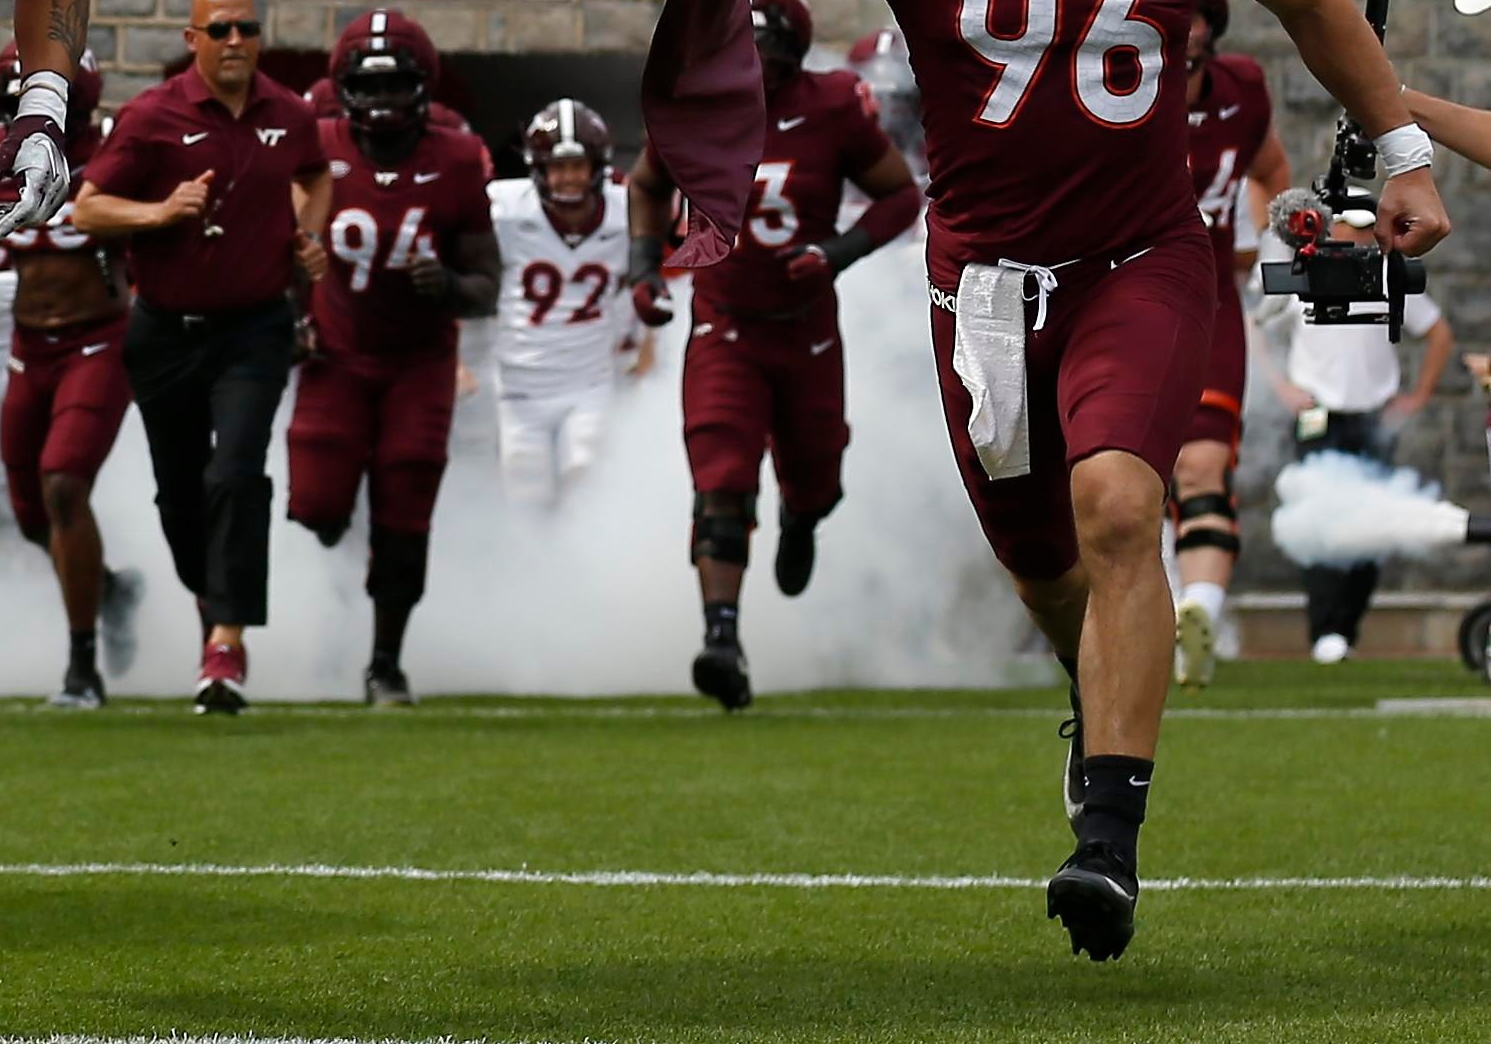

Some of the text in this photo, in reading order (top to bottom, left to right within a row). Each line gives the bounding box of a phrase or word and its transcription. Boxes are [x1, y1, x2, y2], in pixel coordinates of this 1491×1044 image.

[255, 127, 287, 146] VT
[737, 160, 800, 248] 3
[330, 207, 438, 292] 94
[522, 259, 608, 329] 92
